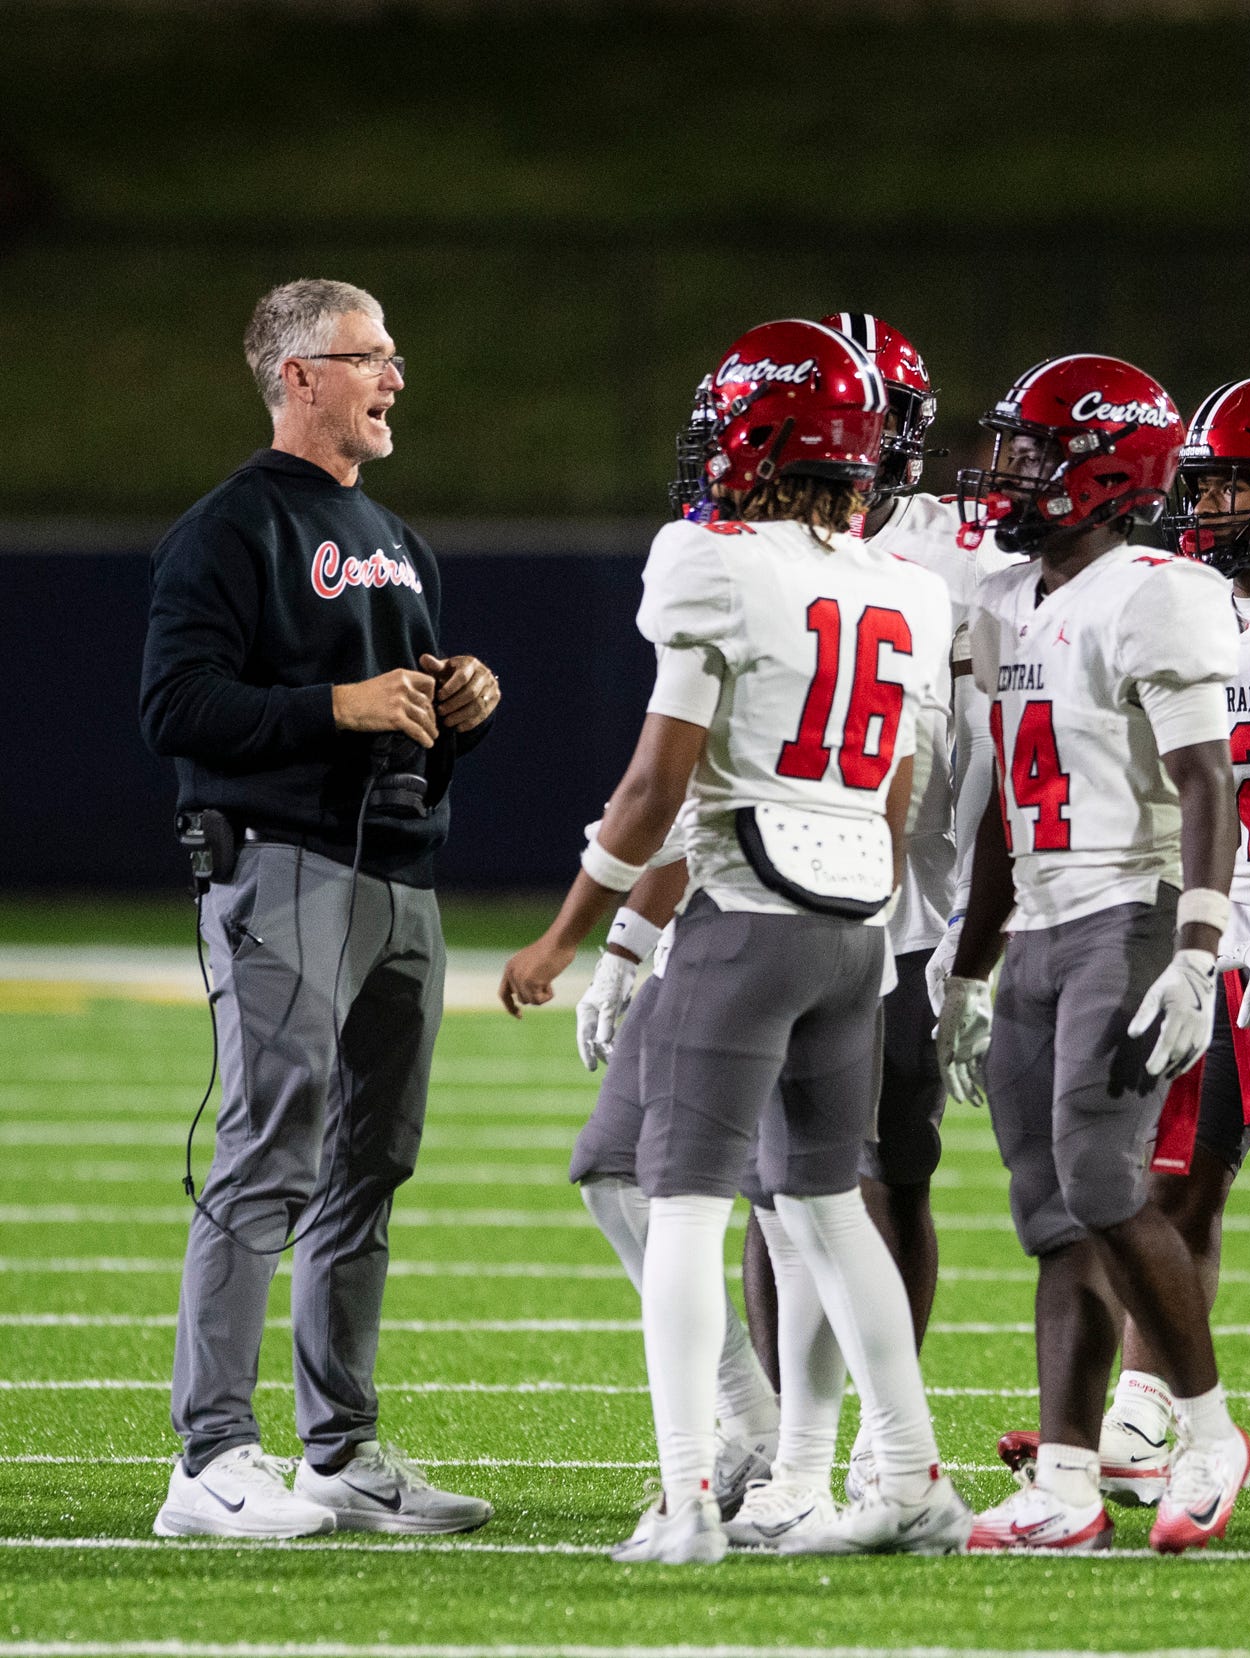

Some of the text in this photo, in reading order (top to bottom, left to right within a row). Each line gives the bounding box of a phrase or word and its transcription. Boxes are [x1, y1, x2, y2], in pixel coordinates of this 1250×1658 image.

[716, 352, 814, 386] Central
[1072, 391, 1168, 428] Central
[776, 596, 913, 791] 16
